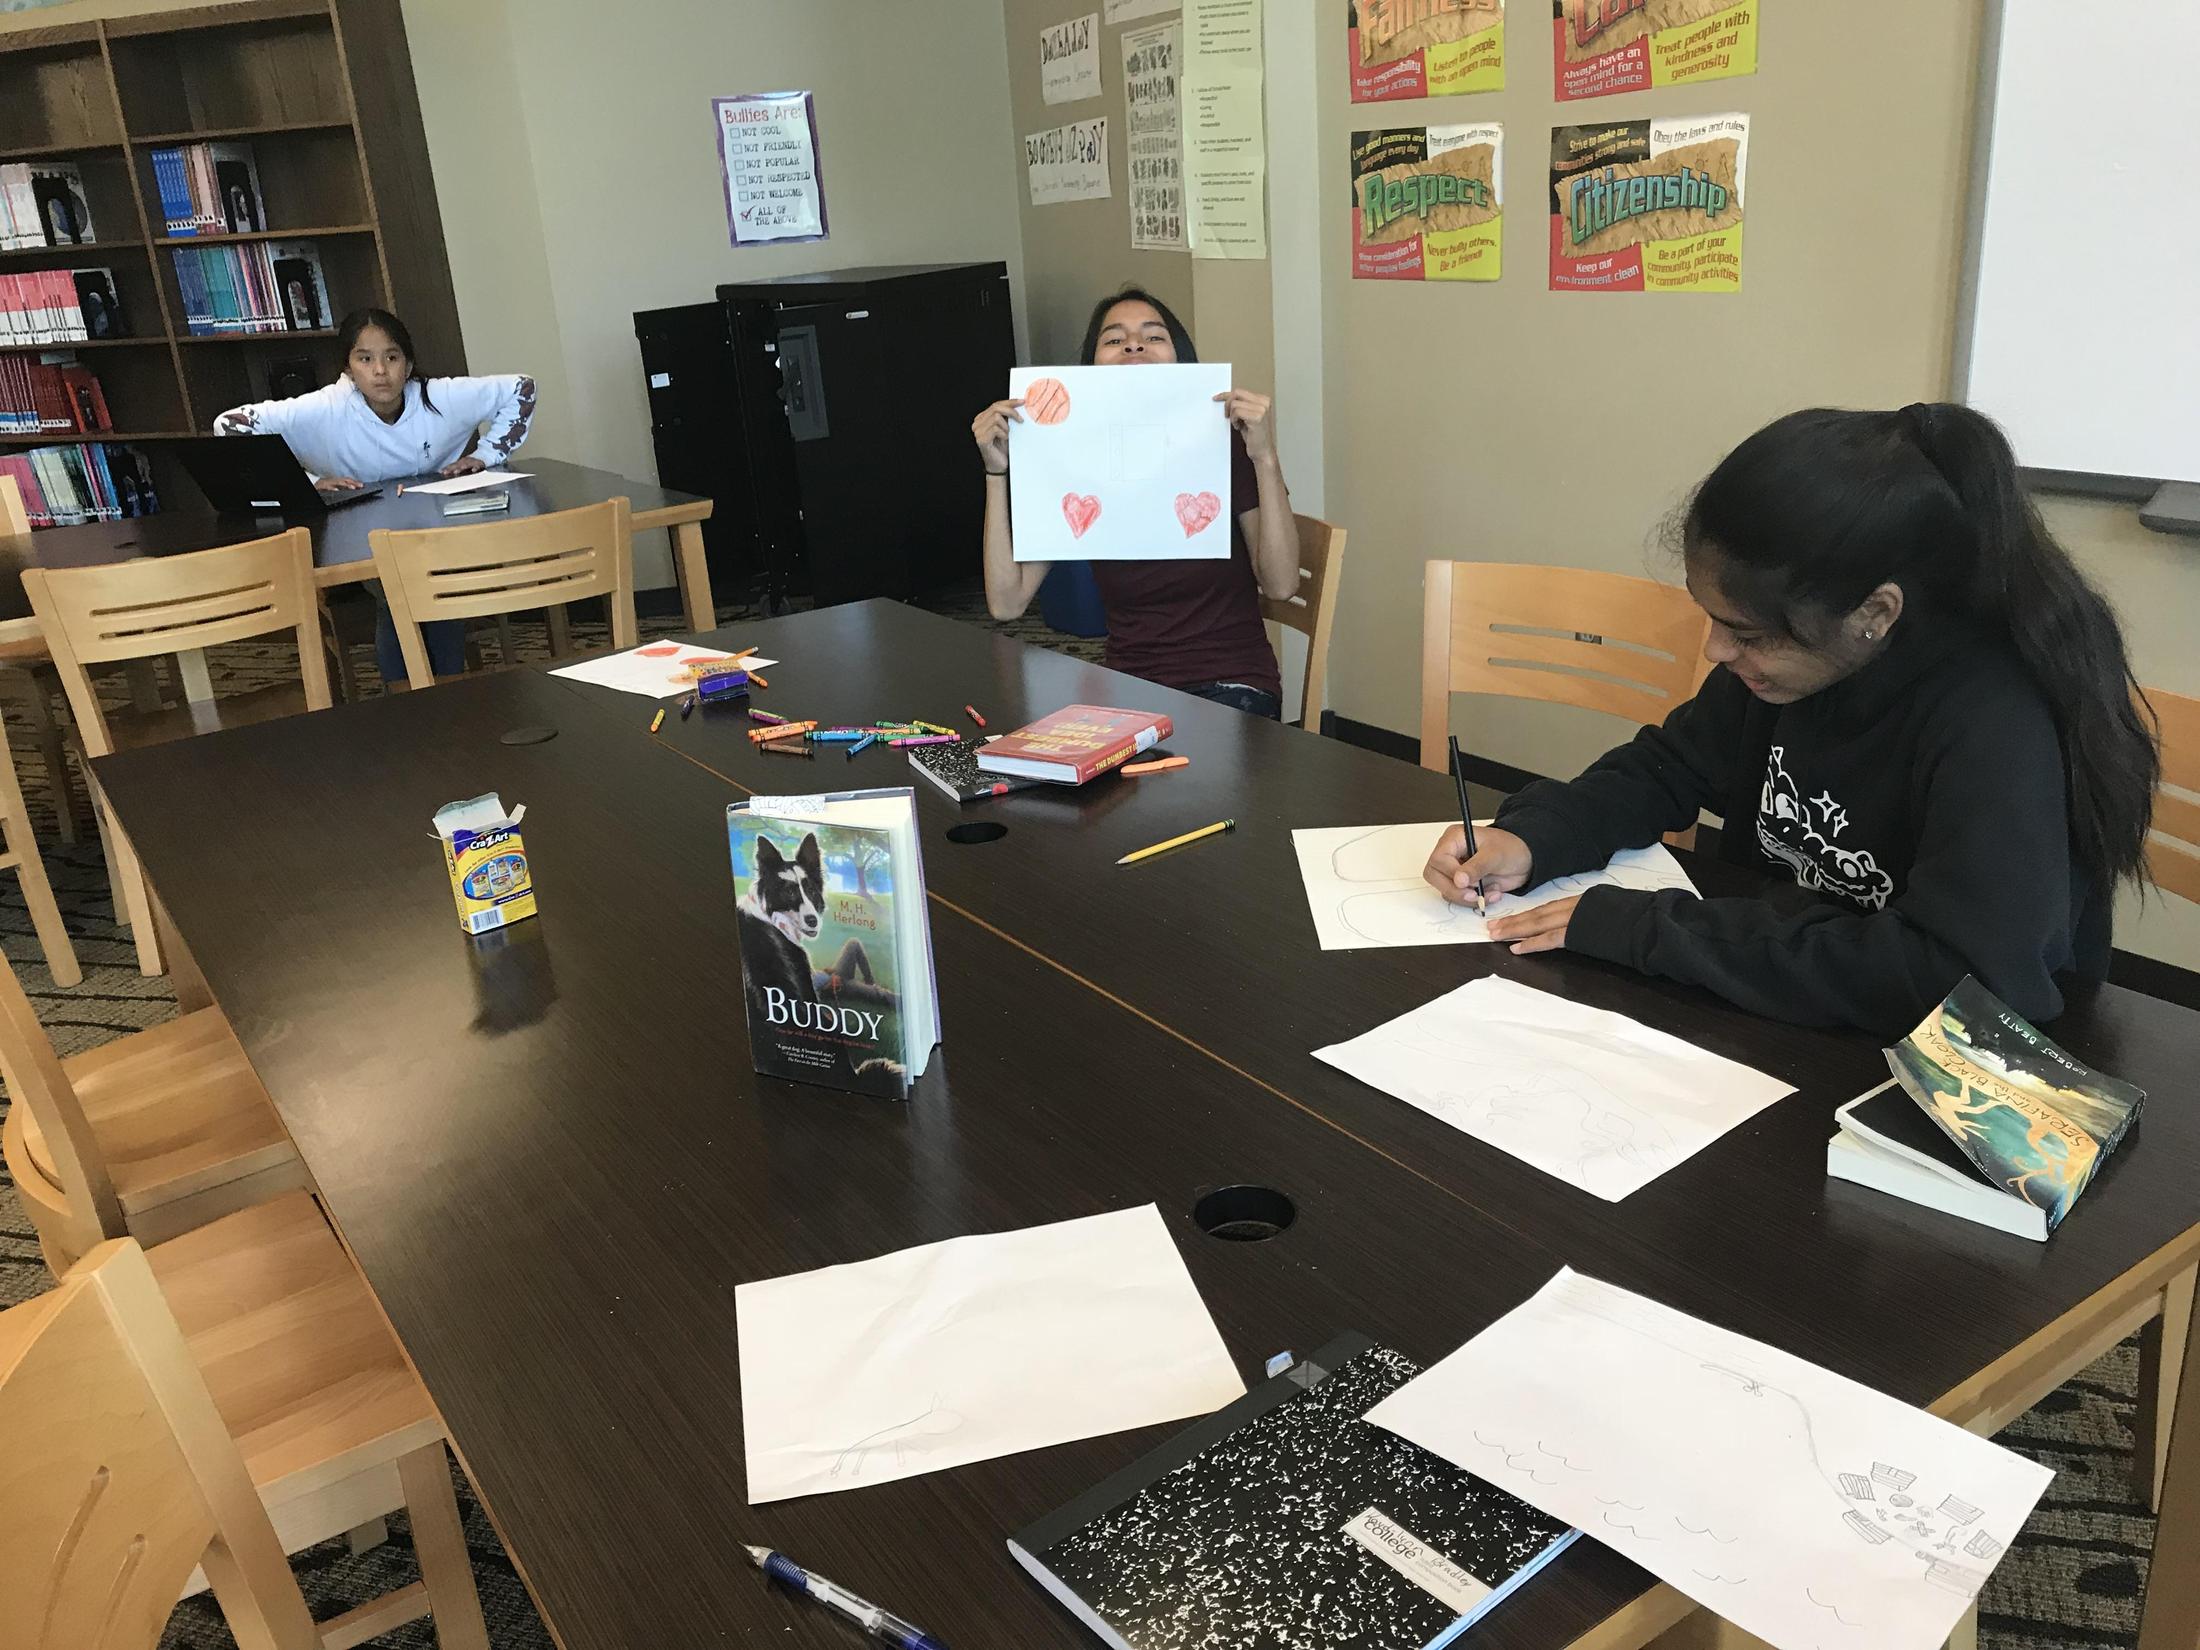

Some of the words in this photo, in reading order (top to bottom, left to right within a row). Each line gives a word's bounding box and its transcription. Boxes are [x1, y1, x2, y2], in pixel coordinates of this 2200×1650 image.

[1656, 41, 1682, 55] Treat
[1684, 22, 1721, 46] people
[1725, 11, 1750, 27] with
[1434, 58, 1458, 71] Listen
[1459, 51, 1468, 62] to
[1469, 38, 1496, 59] people
[1665, 41, 1713, 66] kindness
[1716, 32, 1738, 49] and
[1374, 60, 1421, 84] responsibility
[1459, 61, 1478, 79] open
[1480, 55, 1501, 68] mind
[1563, 62, 1597, 79] Always
[1599, 51, 1624, 67] have
[1627, 48, 1641, 58] an
[1564, 76, 1588, 88] open
[1590, 66, 1615, 82] mind
[1617, 62, 1632, 75] for
[1636, 61, 1643, 70] a
[1671, 54, 1730, 81] generosity
[1568, 83, 1602, 96] second
[1605, 74, 1643, 89] chance
[725, 108, 769, 124] Bullies
[742, 127, 757, 137] NOT
[761, 126, 781, 136] COOL
[1411, 134, 1425, 142] and
[1597, 129, 1616, 143] make
[1654, 129, 1672, 144] Obey
[1673, 130, 1687, 143] the
[1688, 125, 1706, 139] laws
[1708, 120, 1723, 133] and
[1725, 118, 1745, 132] rules
[744, 143, 759, 153] NOT
[746, 159, 761, 169] NOT
[765, 157, 800, 167] POPULAR
[748, 175, 763, 184] NOT
[767, 171, 811, 183] RESPECTED
[751, 190, 765, 200] NOT
[769, 188, 803, 198] WELCOME
[1364, 174, 1488, 238] Respect
[1571, 166, 1727, 246] Citizenship
[755, 217, 770, 226] THE
[758, 206, 773, 216] ALL
[1427, 243, 1448, 256] Never
[1469, 237, 1497, 248] others.
[1659, 250, 1669, 260] Be
[1671, 250, 1676, 259] a
[1678, 243, 1694, 261] part
[1697, 239, 1706, 252] of
[1707, 236, 1726, 250] your
[1440, 260, 1449, 272] Be
[1576, 262, 1597, 274] Keep
[1599, 257, 1613, 269] our
[1694, 251, 1738, 269] participate
[1556, 273, 1612, 285] environment
[1614, 264, 1639, 280] clean
[1656, 272, 1699, 287] community
[1701, 267, 1738, 283] activities
[1095, 758, 1108, 771] THE
[1107, 745, 1133, 766] DUMBEST
[840, 900, 853, 913] M.
[855, 902, 867, 915] H.
[833, 911, 876, 931] Herlong
[763, 986, 884, 1041] BUDDY
[1998, 1012, 2039, 1045] BEATTY
[1920, 1024, 1966, 1066] CLOAK
[1939, 1061, 1989, 1087] BLACK
[2041, 1047, 2088, 1077] ROBERT
[1994, 1088, 2090, 1148] SERAFINA
[1364, 1521, 1416, 1560] college
[1431, 1558, 1472, 1587] Bradley
